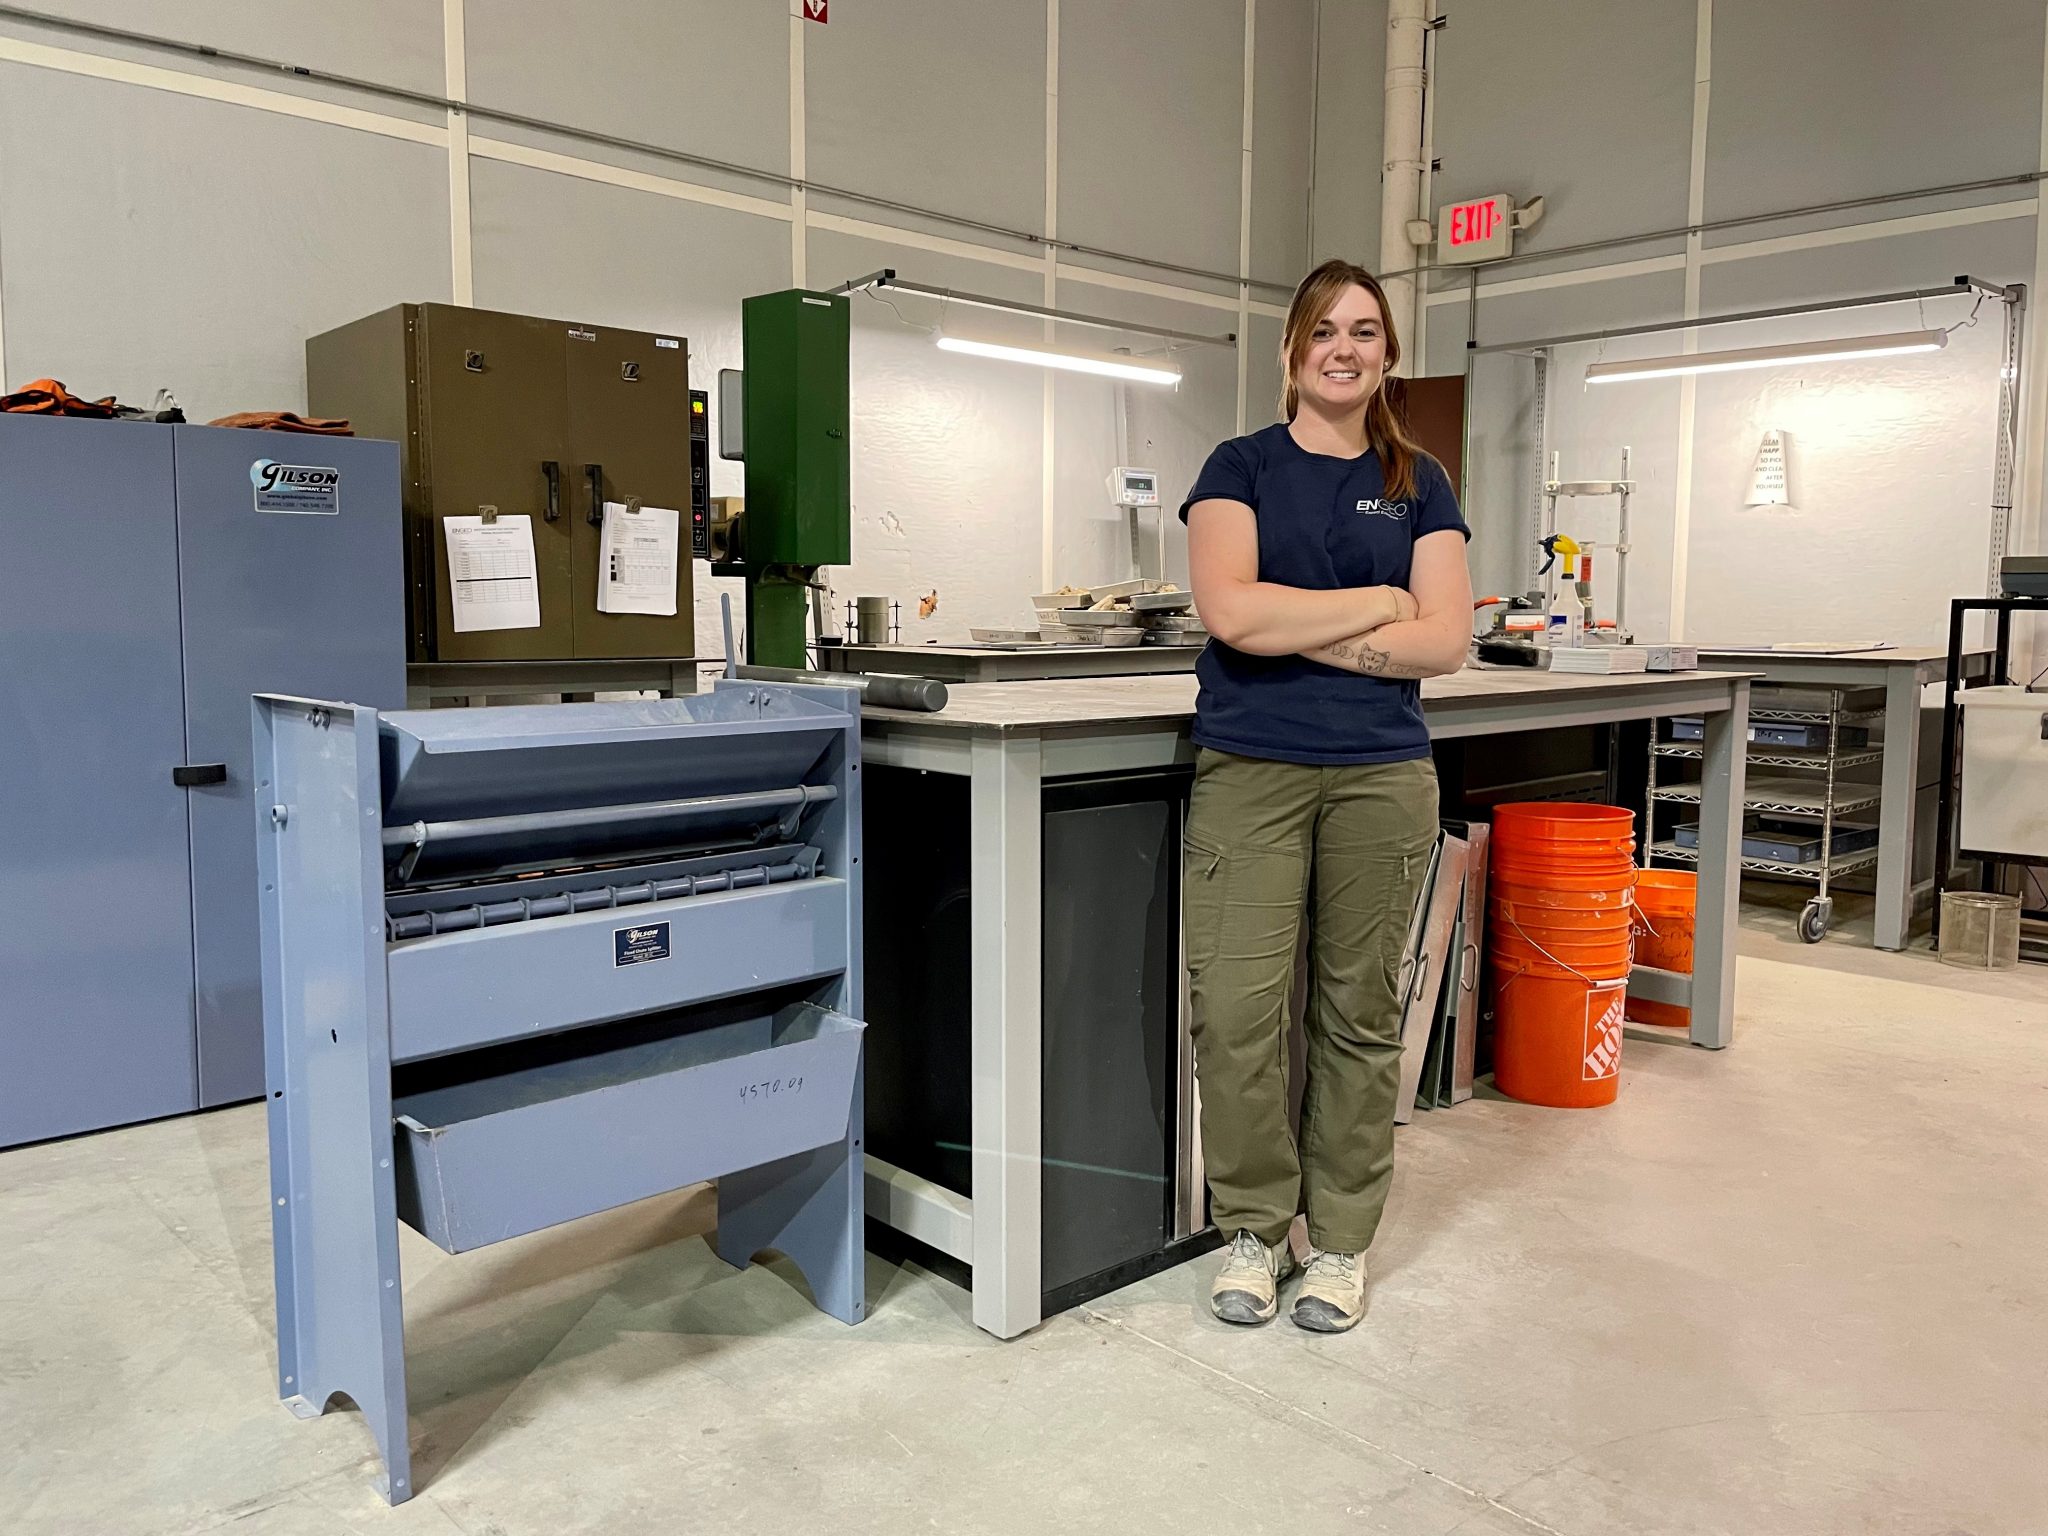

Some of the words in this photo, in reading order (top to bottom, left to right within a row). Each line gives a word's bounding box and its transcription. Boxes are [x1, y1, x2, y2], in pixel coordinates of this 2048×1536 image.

[1450, 200, 1496, 247] EXIT
[260, 463, 339, 492] GILSON
[1585, 1020, 1622, 1078] HO
